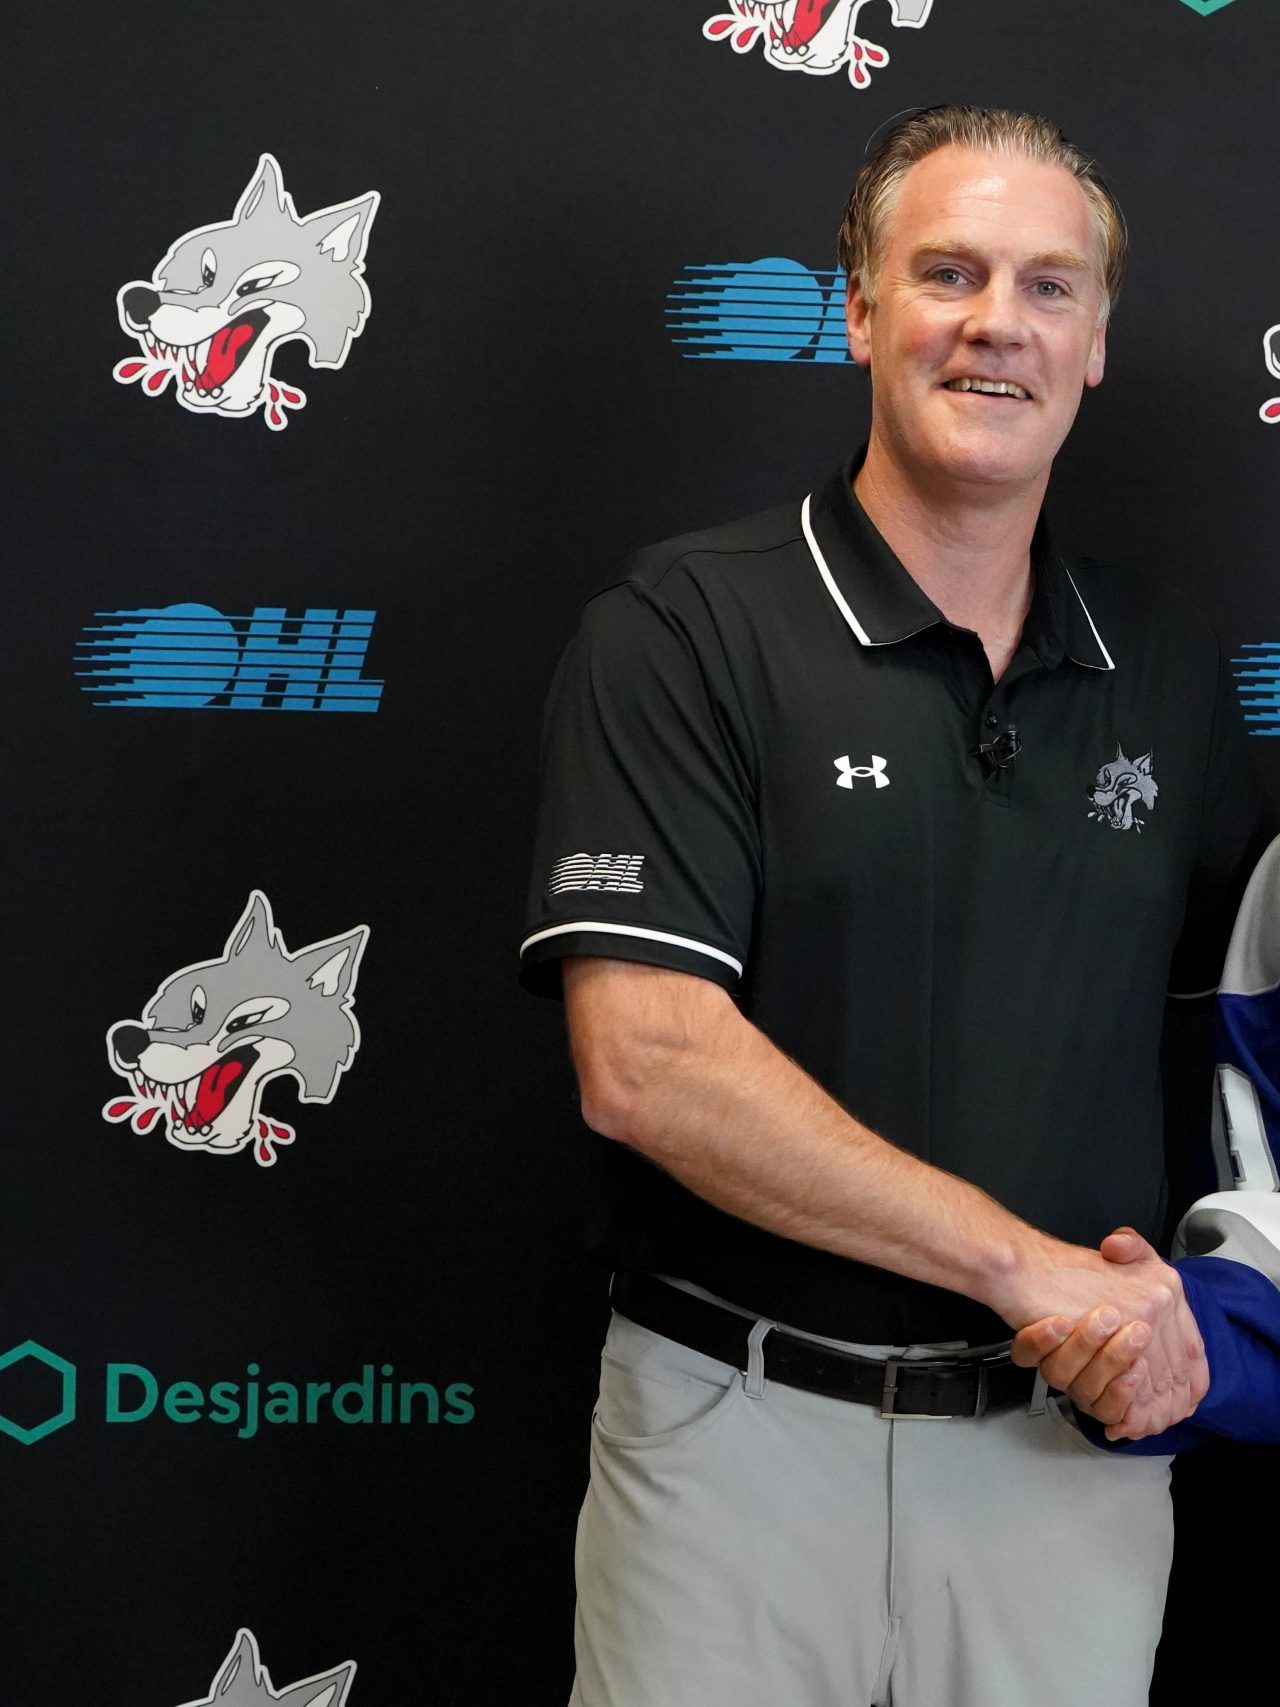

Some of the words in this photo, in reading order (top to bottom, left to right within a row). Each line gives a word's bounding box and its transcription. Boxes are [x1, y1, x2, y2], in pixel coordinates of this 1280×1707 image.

[73, 602, 385, 712] OHL
[548, 853, 645, 896] OHL
[106, 1363, 475, 1439] Desjardins
